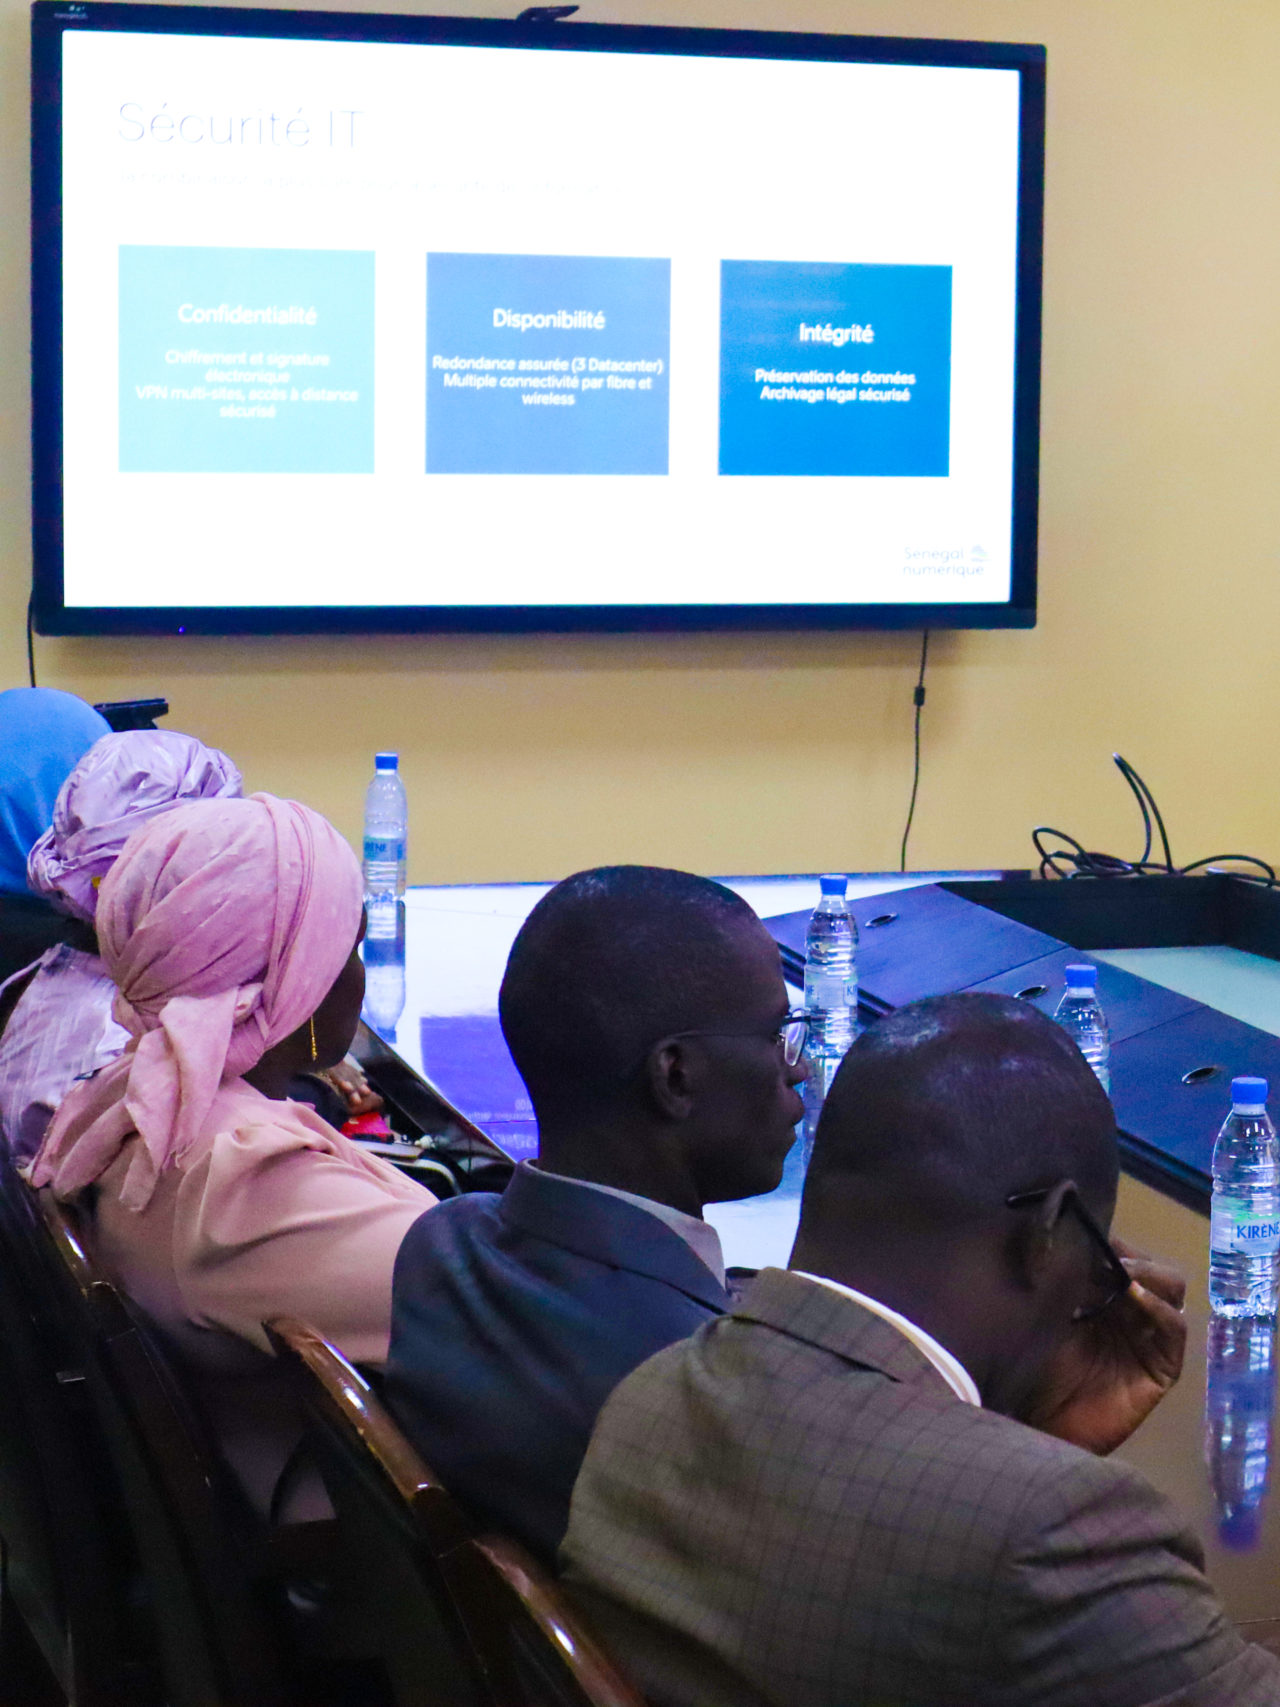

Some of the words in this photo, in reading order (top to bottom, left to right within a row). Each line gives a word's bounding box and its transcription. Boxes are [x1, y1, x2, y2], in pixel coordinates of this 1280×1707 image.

[118, 102, 310, 148] Sécurité
[328, 109, 367, 149] IT
[177, 303, 318, 326] Confidentialité
[492, 308, 606, 332] Disponibilité
[799, 323, 875, 347] Intégrité
[165, 349, 247, 366] Chiffrement
[249, 352, 264, 366] et
[266, 351, 330, 368] signature
[432, 355, 516, 371] Redondance
[518, 357, 569, 372] assurée
[571, 357, 587, 374] (3
[588, 358, 664, 375] Datacenter)
[204, 368, 291, 386] électronique
[443, 373, 497, 390] Multiple
[499, 374, 579, 390] connectivité
[581, 377, 604, 392] par
[606, 375, 637, 390] fibre
[638, 377, 652, 390] et
[754, 368, 834, 384] Préservation
[835, 370, 859, 385] des
[861, 371, 916, 386] données
[135, 385, 168, 400] VPN
[301, 387, 359, 403] distance
[521, 391, 576, 406] wireless
[759, 385, 825, 403] Archivage
[826, 387, 857, 403] légal
[858, 387, 911, 402] sécurisé
[219, 403, 277, 419] sécurisé
